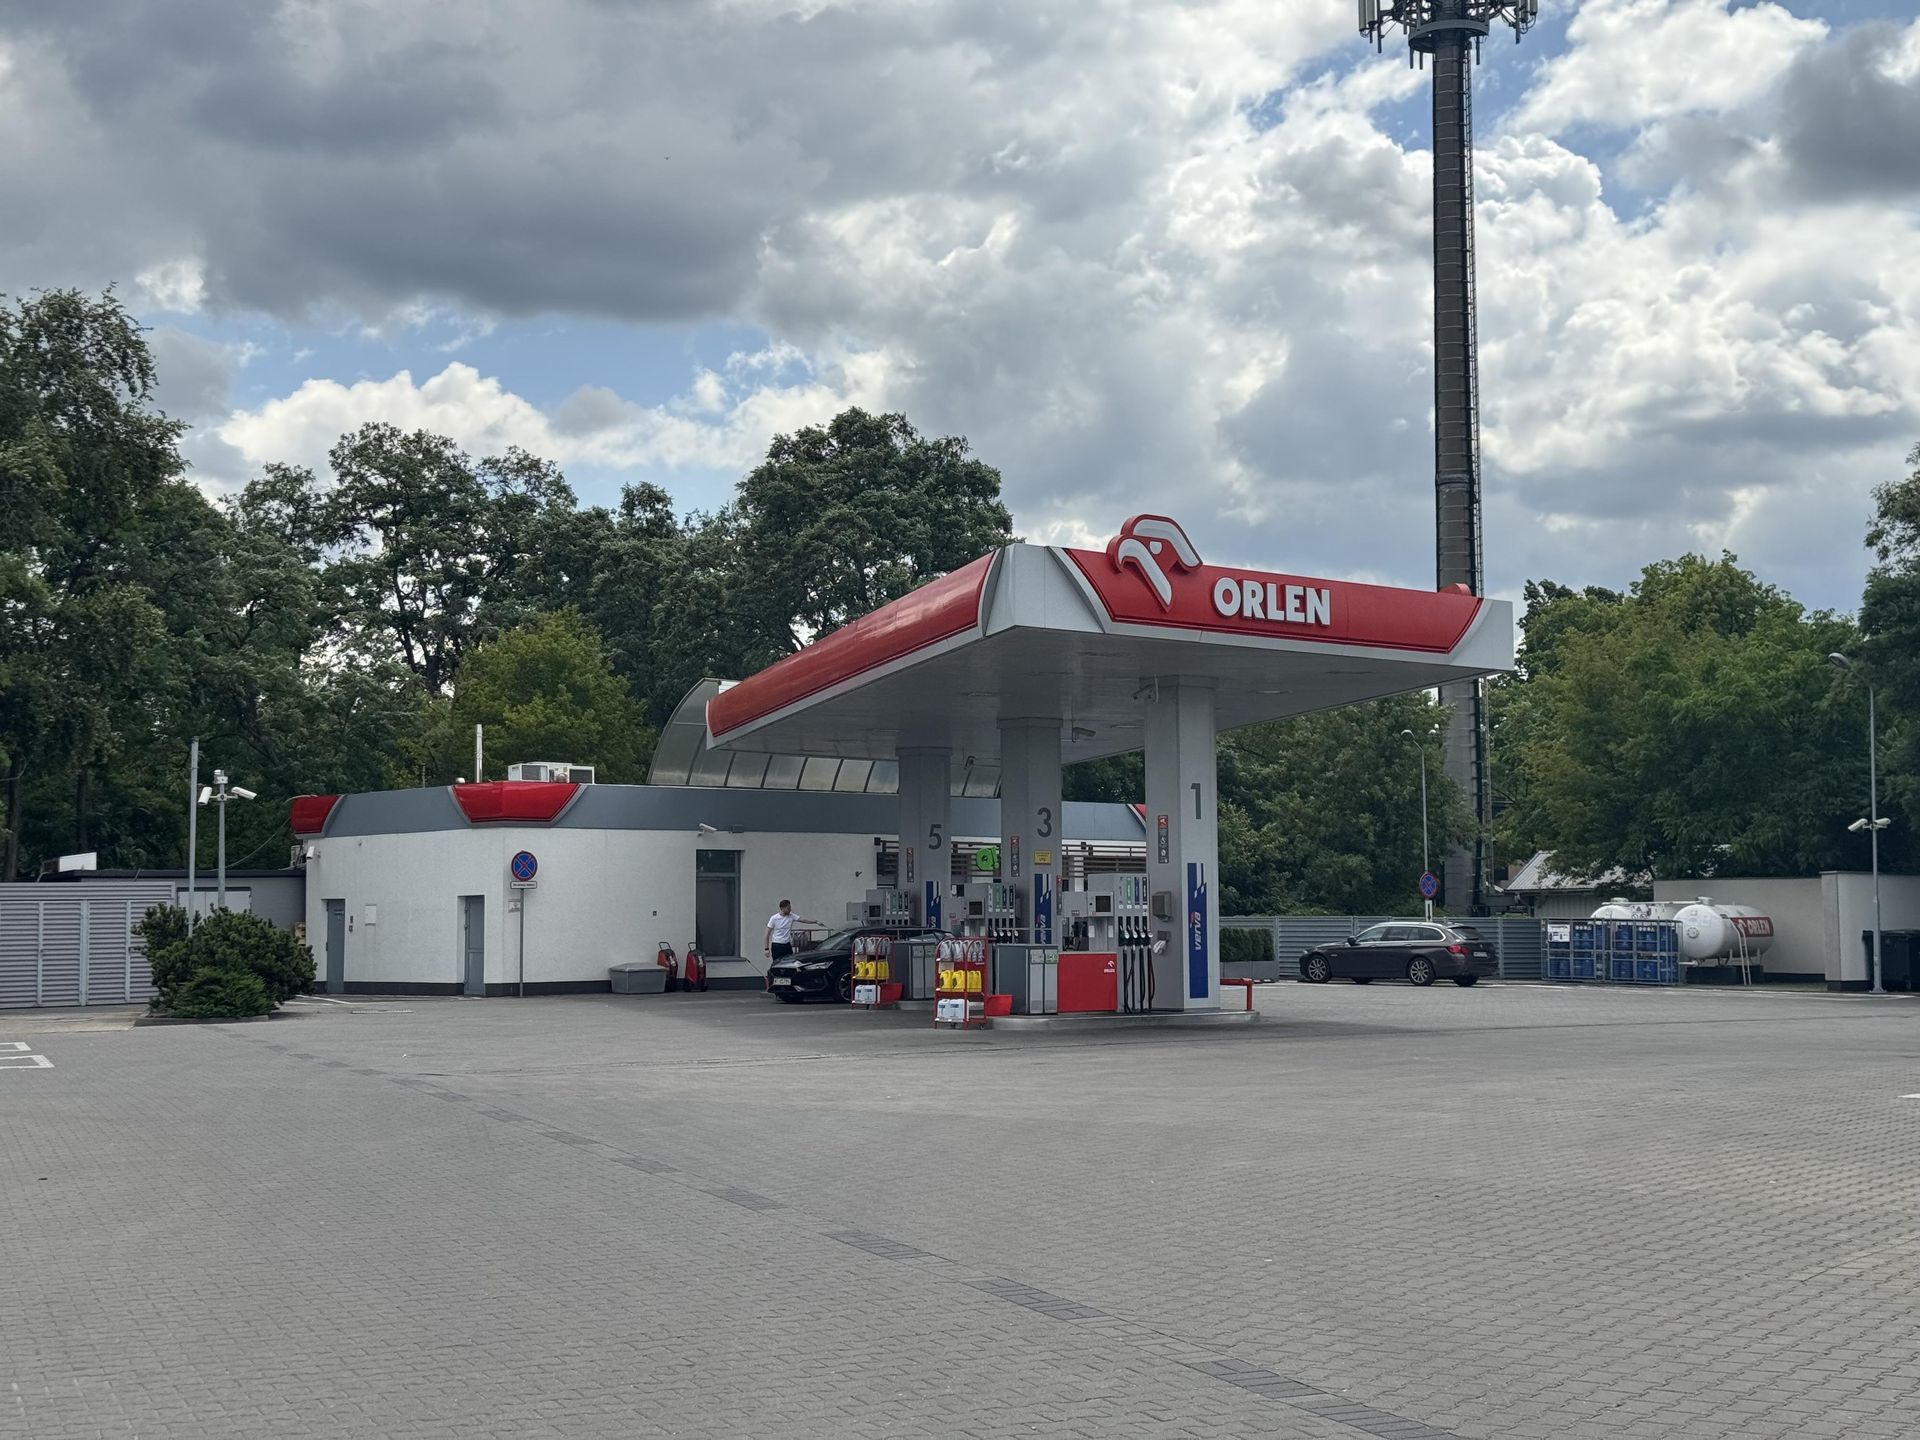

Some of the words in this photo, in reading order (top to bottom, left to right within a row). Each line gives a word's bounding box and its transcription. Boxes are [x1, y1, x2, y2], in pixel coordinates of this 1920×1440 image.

[1213, 576, 1331, 626] ORLEN
[1190, 782, 1202, 820] 1
[928, 823, 942, 850] 5
[1037, 807, 1052, 838] 3
